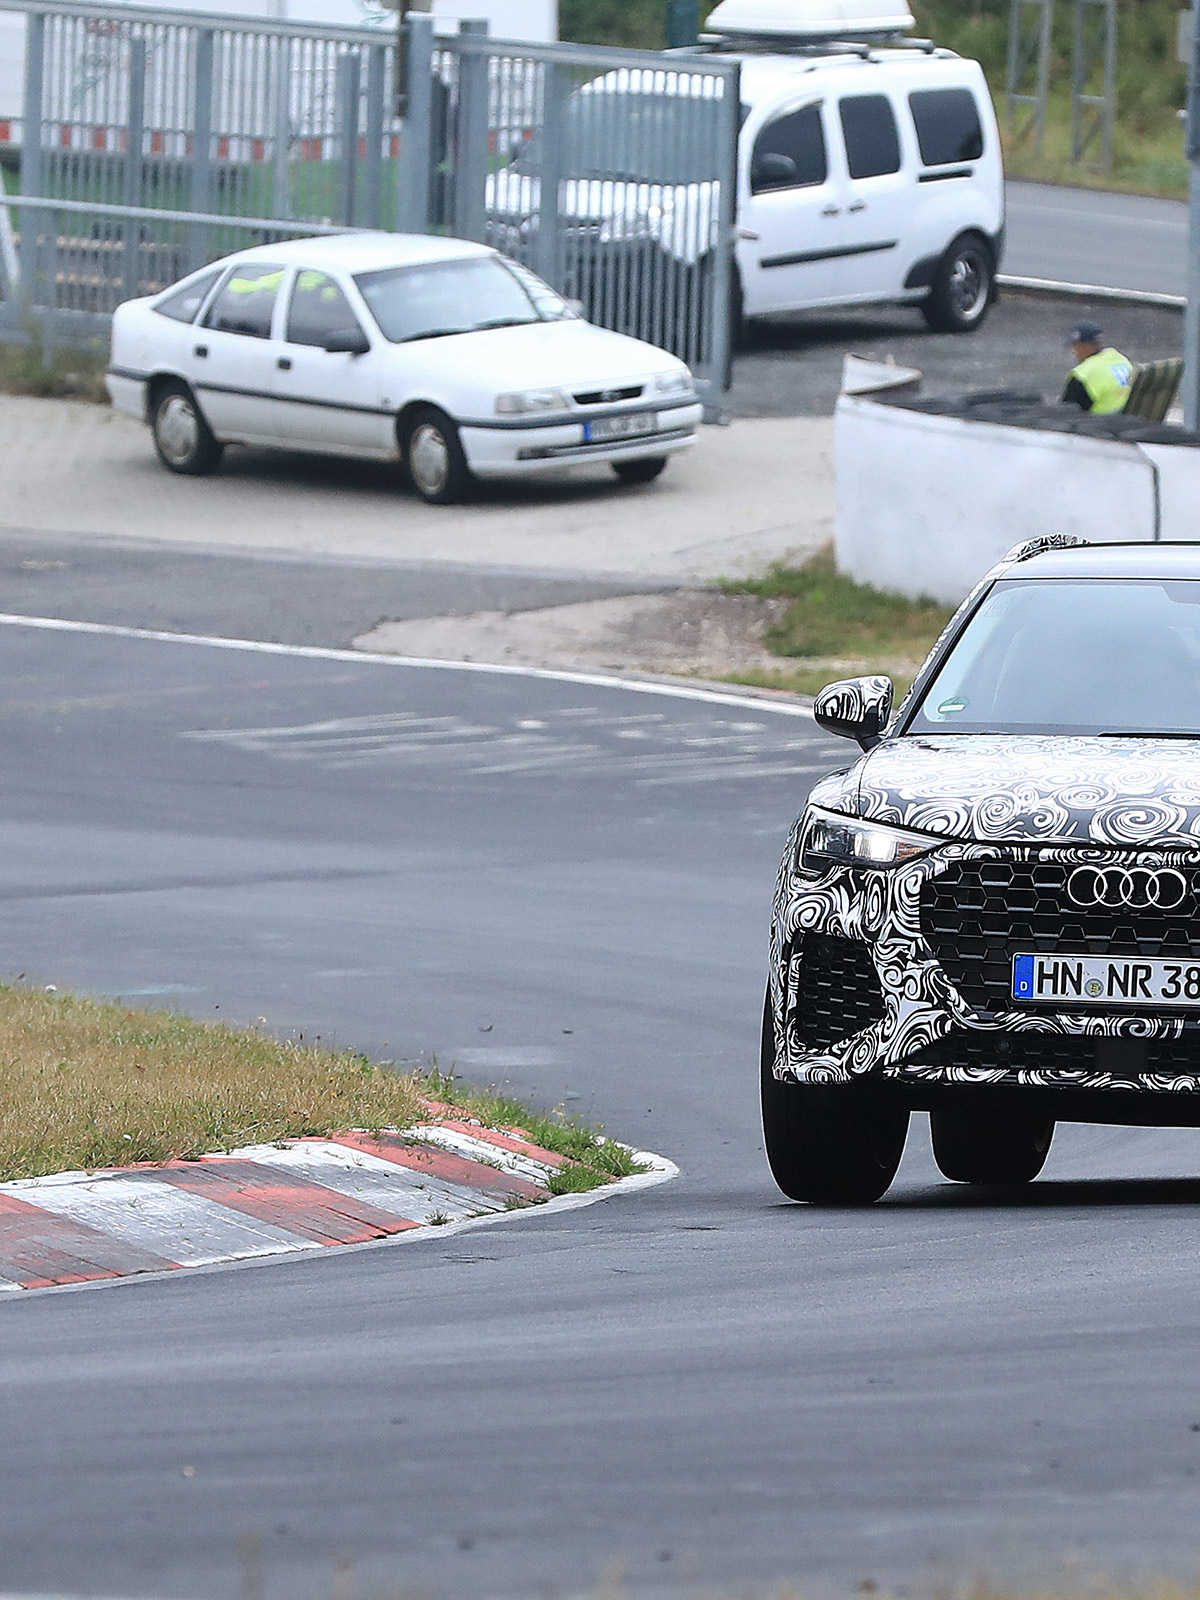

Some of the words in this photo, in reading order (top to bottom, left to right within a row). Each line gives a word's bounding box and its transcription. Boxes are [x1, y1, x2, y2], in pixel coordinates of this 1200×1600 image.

[1020, 981, 1028, 991] D
[1037, 961, 1083, 996] HN
[1107, 963, 1152, 998] NR
